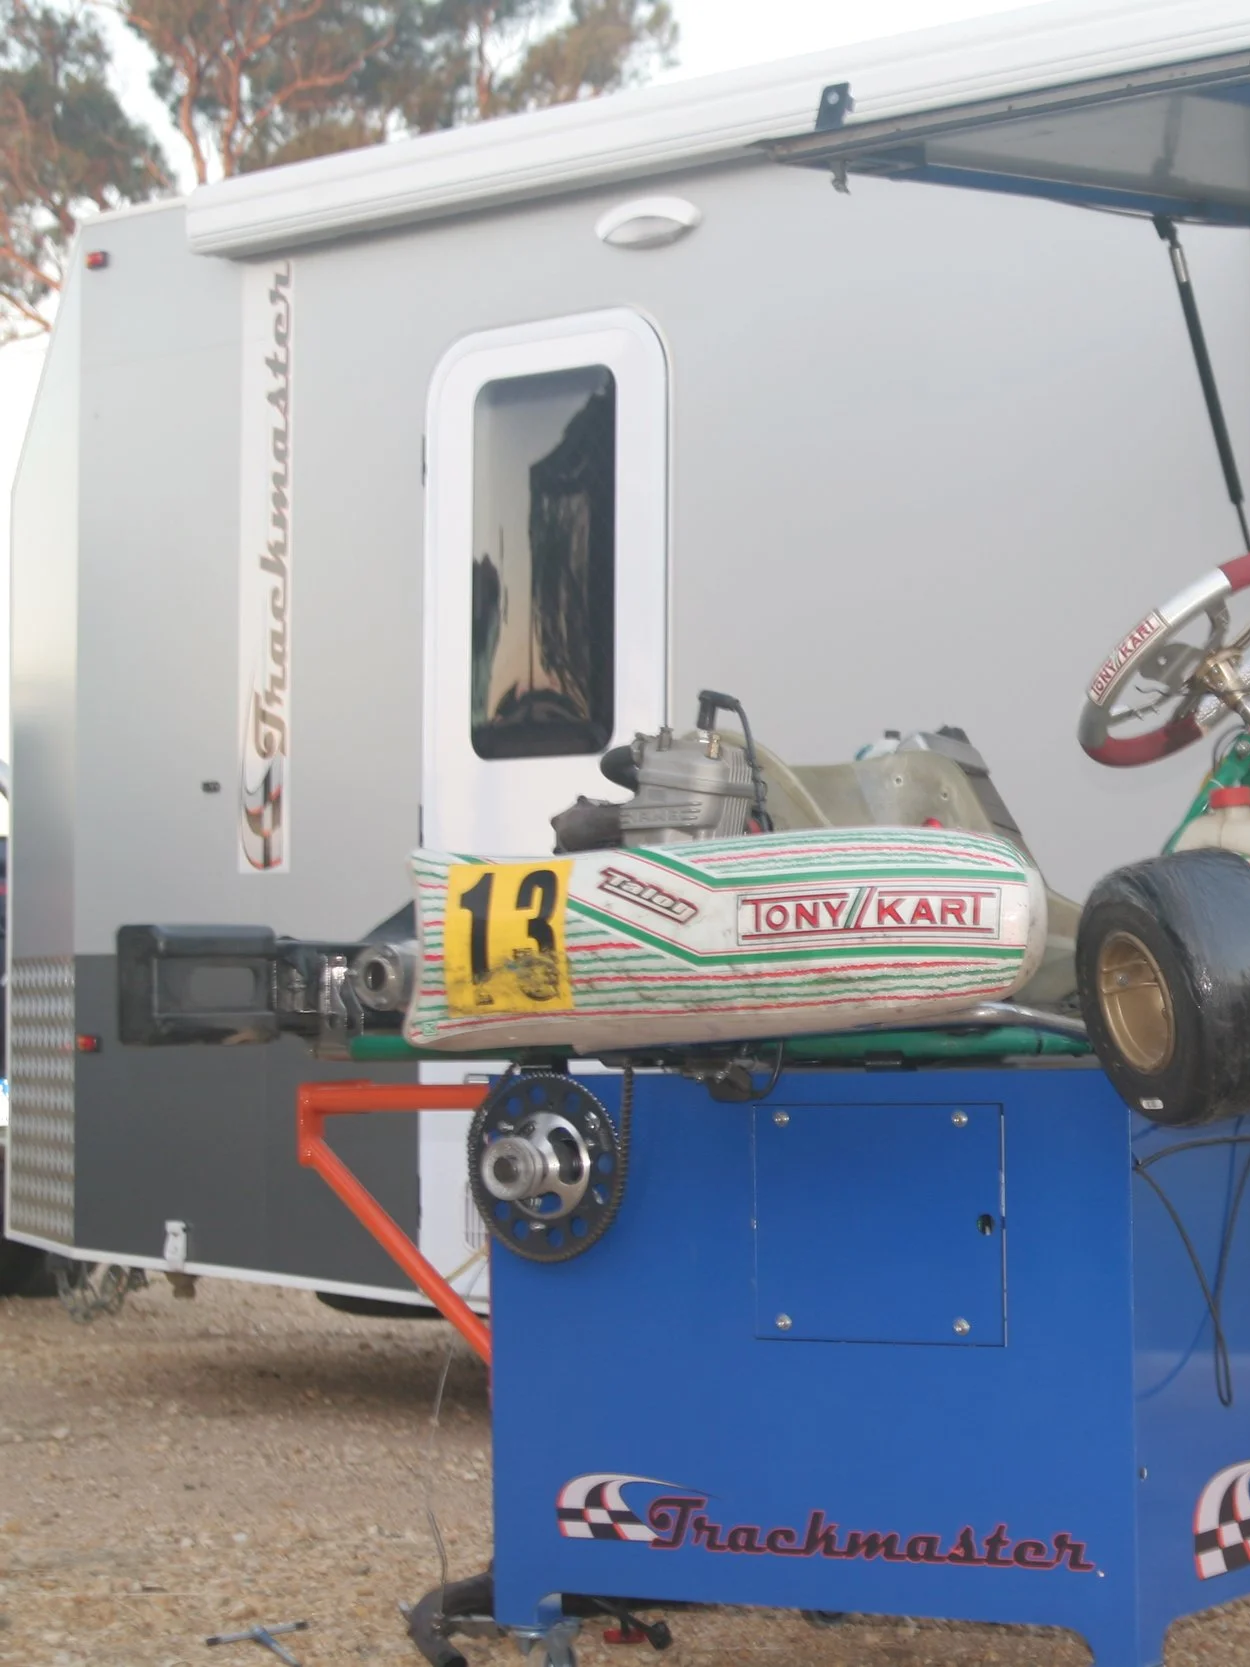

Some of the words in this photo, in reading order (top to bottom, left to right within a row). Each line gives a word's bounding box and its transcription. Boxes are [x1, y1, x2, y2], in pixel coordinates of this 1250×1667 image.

[253, 258, 293, 760] Trackmaster
[459, 868, 561, 1003] 13
[646, 1495, 1097, 1573] Trackmaster
